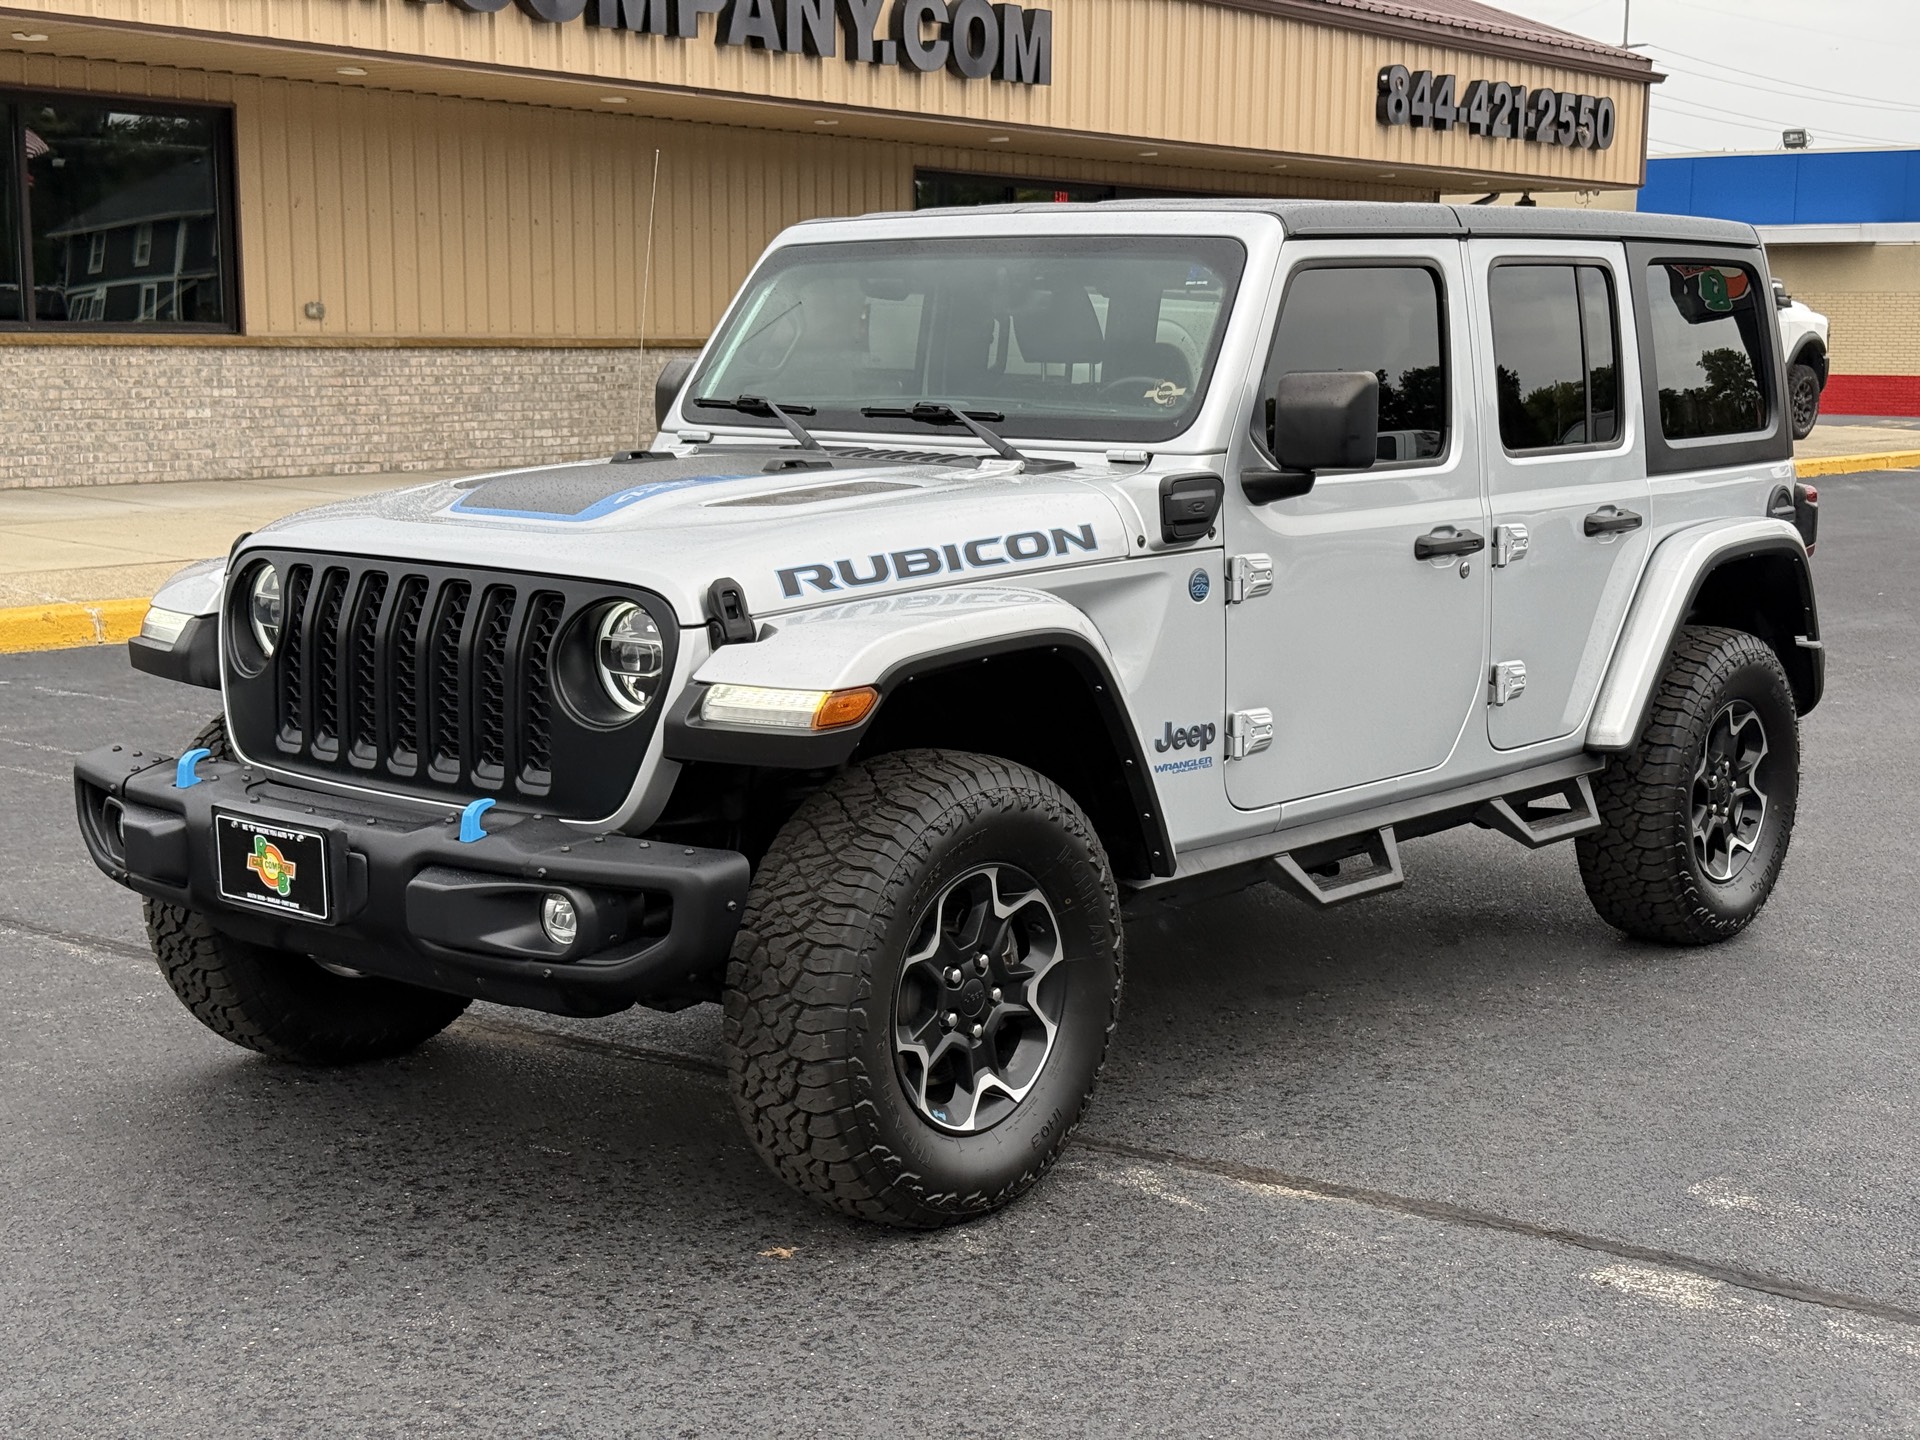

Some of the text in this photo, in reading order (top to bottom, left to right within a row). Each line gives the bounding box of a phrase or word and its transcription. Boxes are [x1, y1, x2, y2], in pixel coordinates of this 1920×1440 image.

[447, 0, 1052, 86] ANY.COM
[774, 523, 1098, 599] RUBICON
[1155, 721, 1216, 753] Jeep
[1154, 756, 1212, 773] WRANGLER
[1172, 764, 1212, 774] UNLIMITED
[255, 836, 268, 859] R
[278, 872, 289, 894] B
